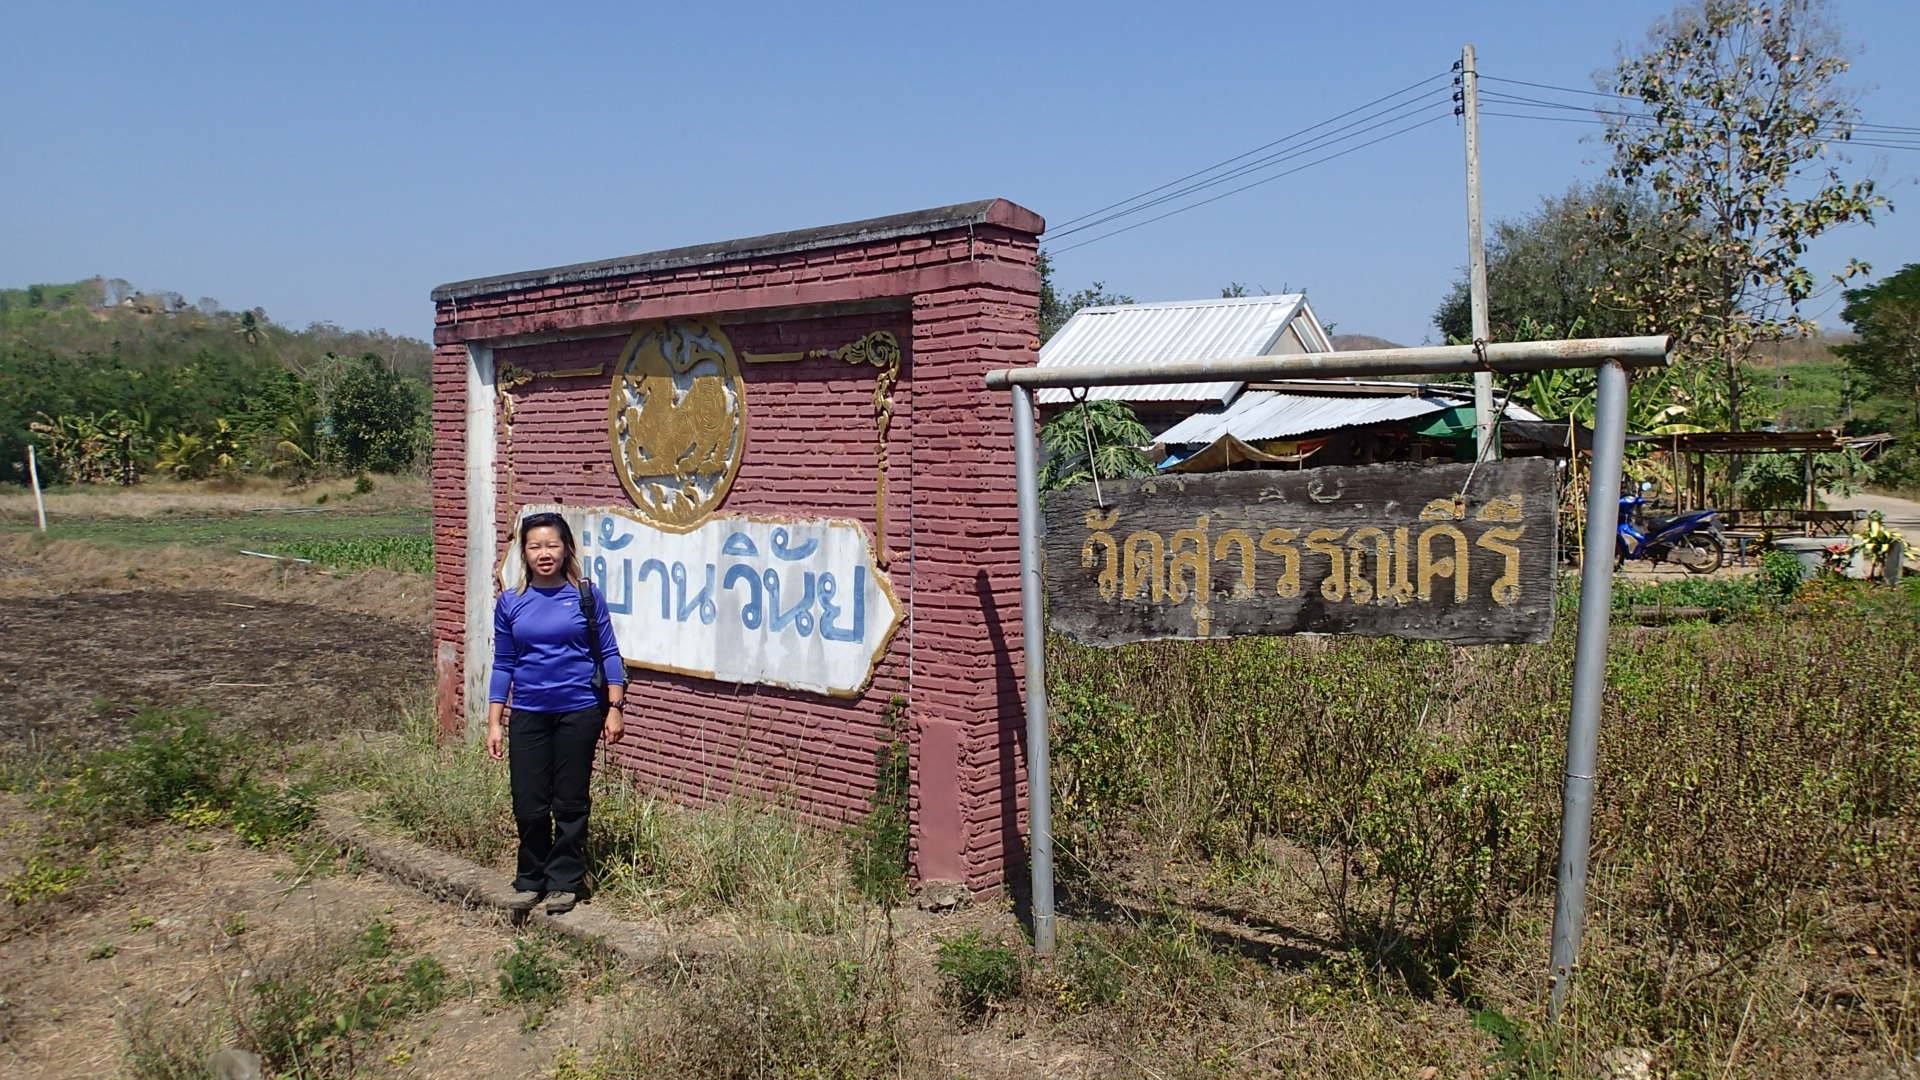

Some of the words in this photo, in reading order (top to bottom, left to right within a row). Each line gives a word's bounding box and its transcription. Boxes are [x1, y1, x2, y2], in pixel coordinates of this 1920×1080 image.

[583, 516, 866, 644] ่บ้านวินัย
[1081, 495, 1525, 636] วัดสุวรรณคีรี
